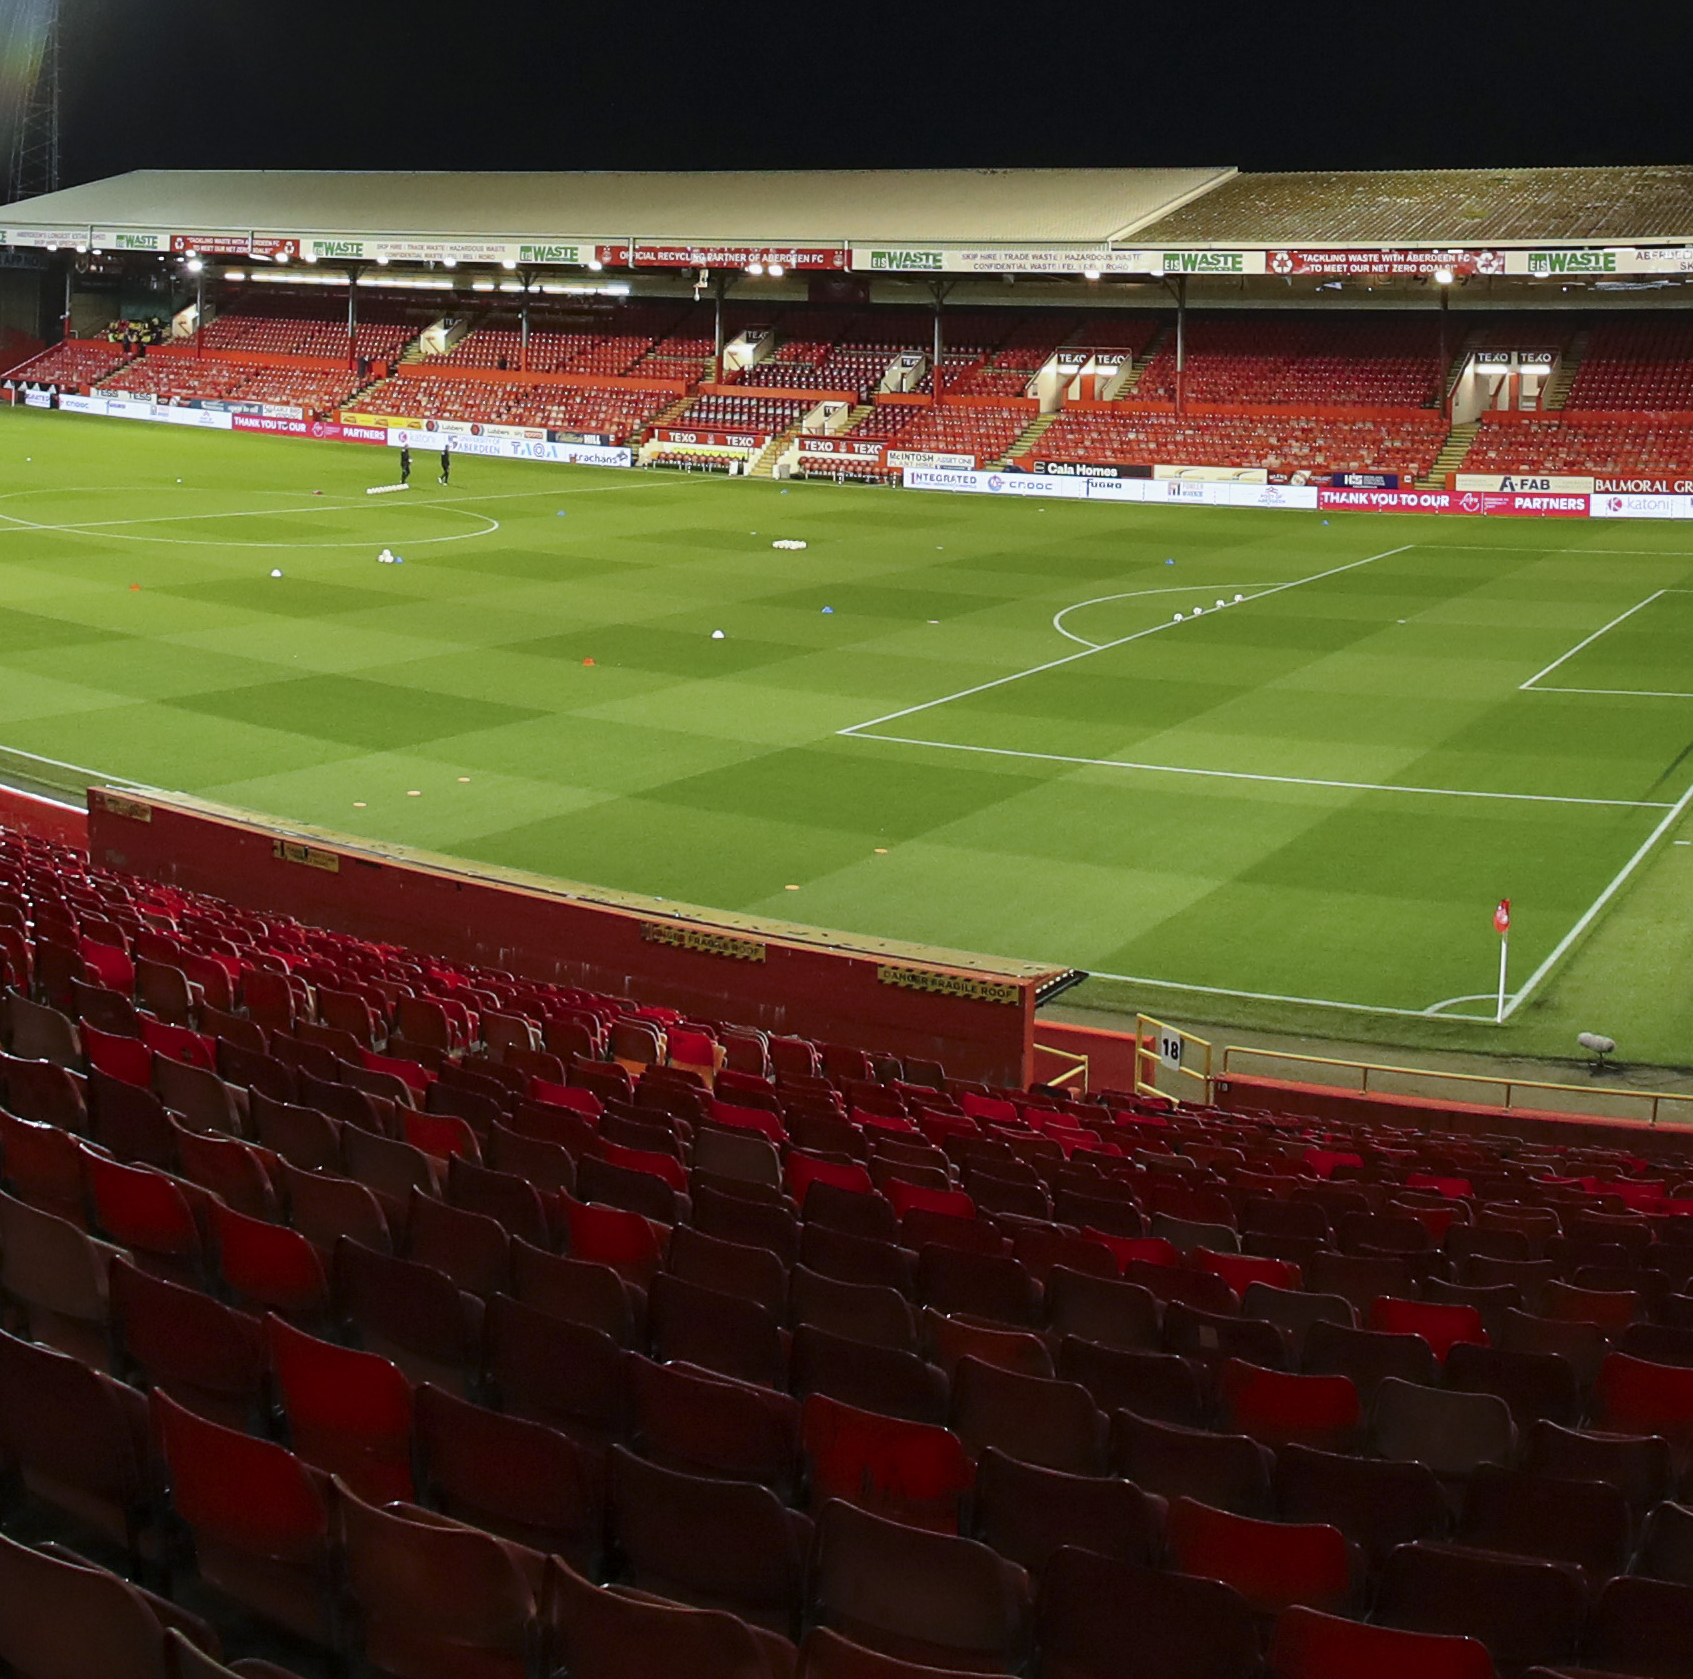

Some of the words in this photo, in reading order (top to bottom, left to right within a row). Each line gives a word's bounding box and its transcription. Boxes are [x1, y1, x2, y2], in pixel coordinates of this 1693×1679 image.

[125, 235, 158, 249] WASTE
[324, 242, 363, 257] WASTE
[533, 246, 578, 262] WASTE
[657, 252, 705, 262] RECYCLING
[707, 253, 746, 262] PARTNER
[748, 253, 760, 262] OF
[762, 253, 810, 263] ABERDEEN
[811, 254, 823, 263] FC
[873, 257, 887, 268] EIS
[888, 252, 942, 269] WASTE
[1164, 260, 1179, 270] EIS
[1181, 254, 1242, 271] WASTE
[1348, 254, 1379, 262] WASTE
[1382, 253, 1404, 262] WITH
[1406, 253, 1456, 262] ABERDEEN
[1458, 253, 1471, 262] FC
[1530, 260, 1547, 271] EIS
[1549, 253, 1616, 272] WASTE
[1310, 264, 1322, 272] TO
[1324, 264, 1347, 272] MEET
[1350, 264, 1369, 272] OUR
[1372, 264, 1389, 272] NET
[1392, 264, 1416, 272] ZERO
[1478, 352, 1508, 362] TEXO
[1521, 352, 1552, 362] TEXO
[234, 416, 260, 428] THANK
[261, 419, 276, 430] YOU
[289, 422, 307, 432] OUR
[343, 427, 385, 441] PARTNERS
[669, 432, 697, 443] TEXO
[726, 435, 754, 447] TEXO
[458, 442, 501, 454] ABERDEEN
[511, 441, 558, 458] TAQA
[804, 440, 834, 452] TEXO
[853, 443, 883, 454] TEXO
[889, 452, 934, 462] McINTOSH
[1047, 462, 1075, 475] Cala
[1077, 464, 1118, 477] Homes
[910, 472, 977, 484] INTEGRATED
[1009, 480, 1053, 490] cnooc
[1595, 479, 1670, 493] BALMORAL
[1322, 491, 1368, 505] THANK
[1370, 493, 1397, 505] YOU
[1400, 494, 1418, 506] TO
[1420, 495, 1450, 507] OUR
[1514, 497, 1585, 510] PARTNERS
[1627, 497, 1670, 511] katoni
[883, 969, 928, 986] DANGER
[931, 978, 977, 995] FRAGILE
[981, 986, 1013, 998] ROOF
[1163, 1038, 1178, 1060] 18
